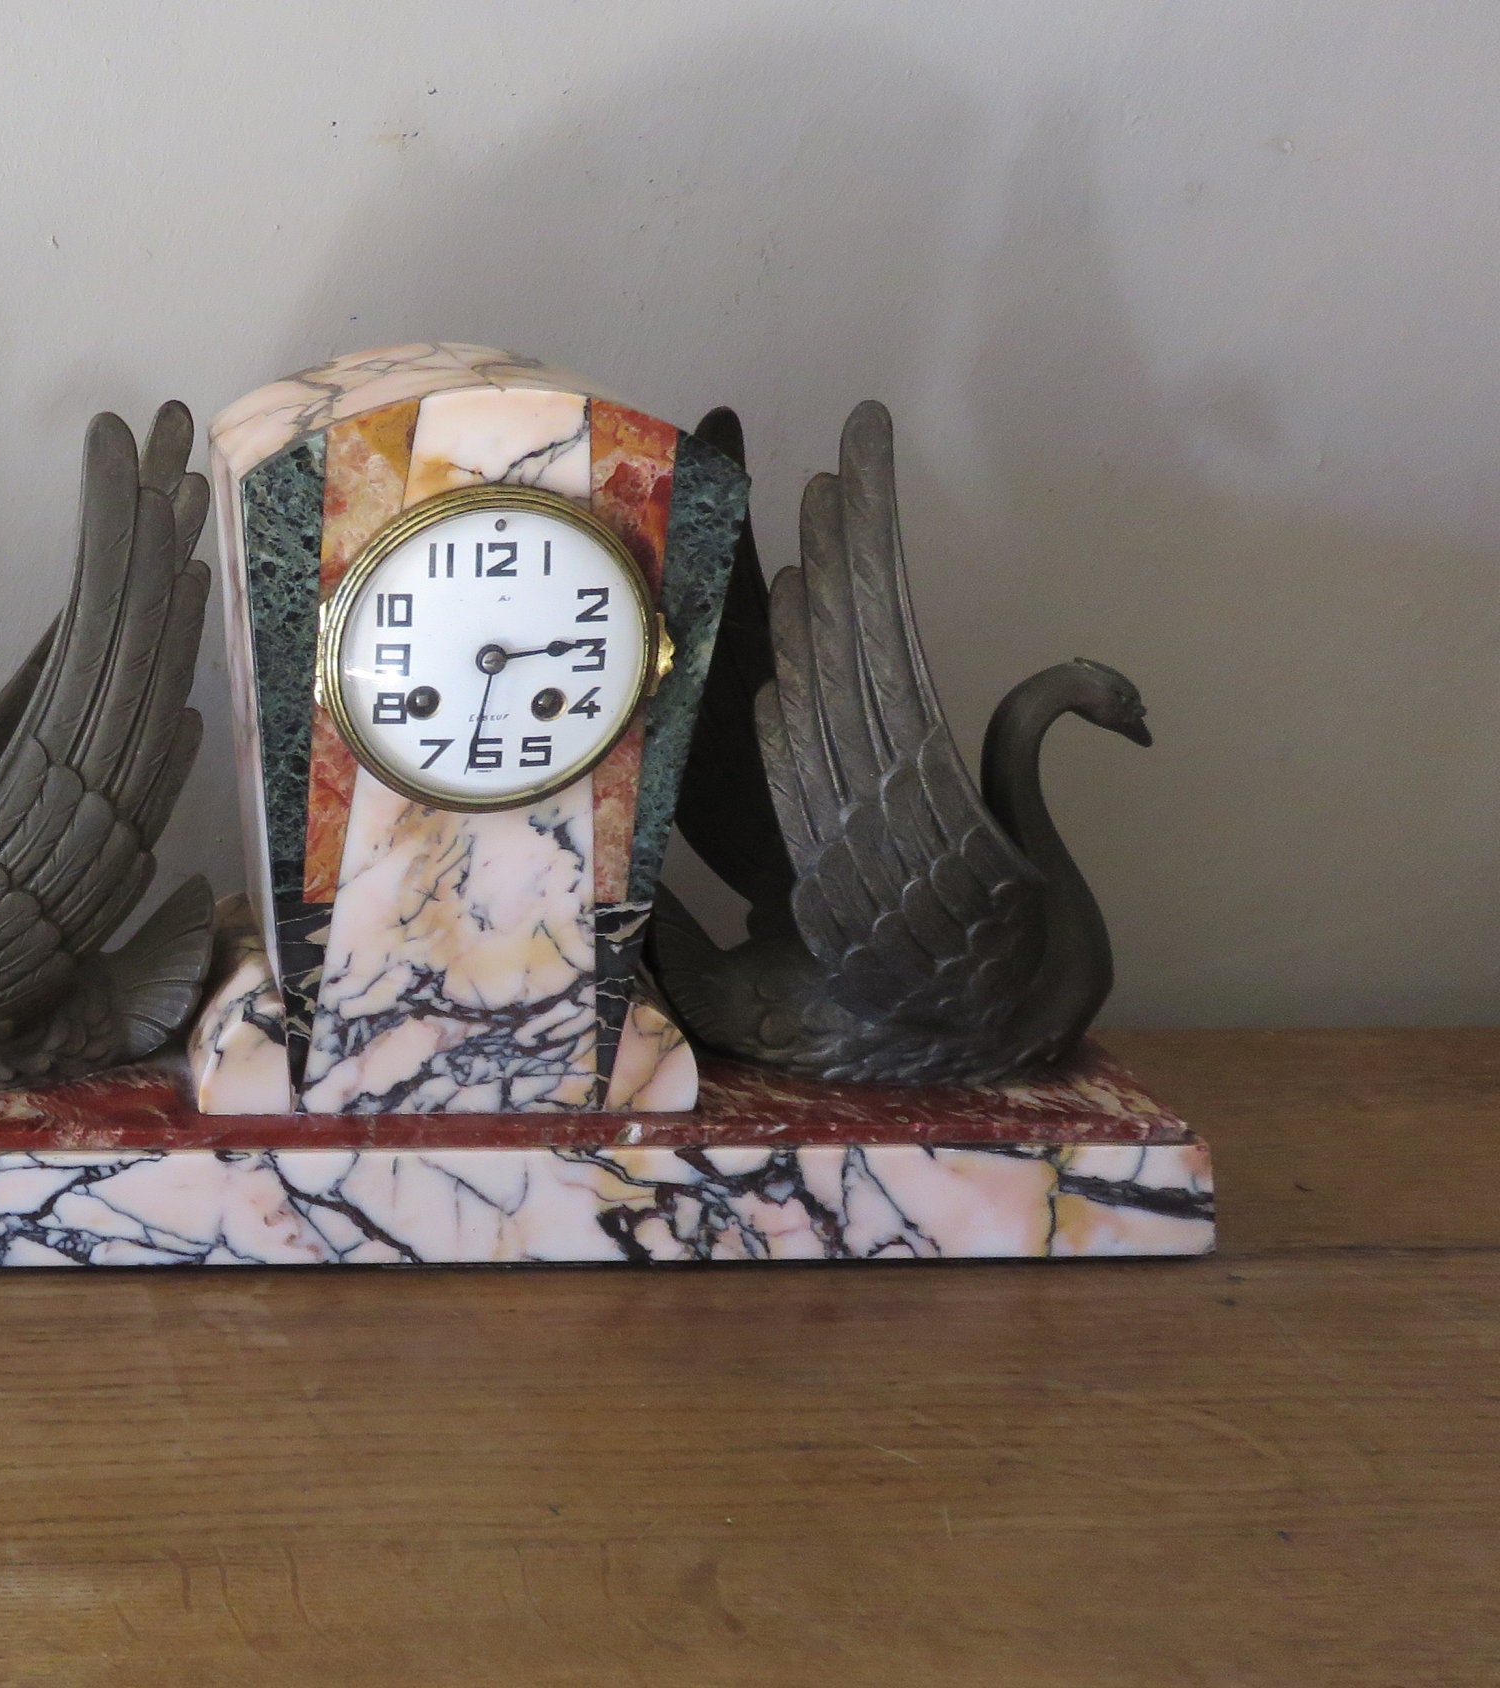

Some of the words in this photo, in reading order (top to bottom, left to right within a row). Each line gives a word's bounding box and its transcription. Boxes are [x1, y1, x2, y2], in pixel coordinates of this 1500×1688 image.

[428, 543, 454, 578] 11
[475, 542, 517, 577] 12
[544, 540, 551, 576] 1
[376, 594, 413, 627] 10
[575, 587, 609, 623] 2
[375, 644, 411, 676] 9
[572, 638, 606, 672] 3
[372, 692, 407, 724] 8
[567, 687, 601, 719] 4
[419, 739, 455, 769] 7
[469, 738, 503, 768] 6
[519, 736, 553, 768] 5
